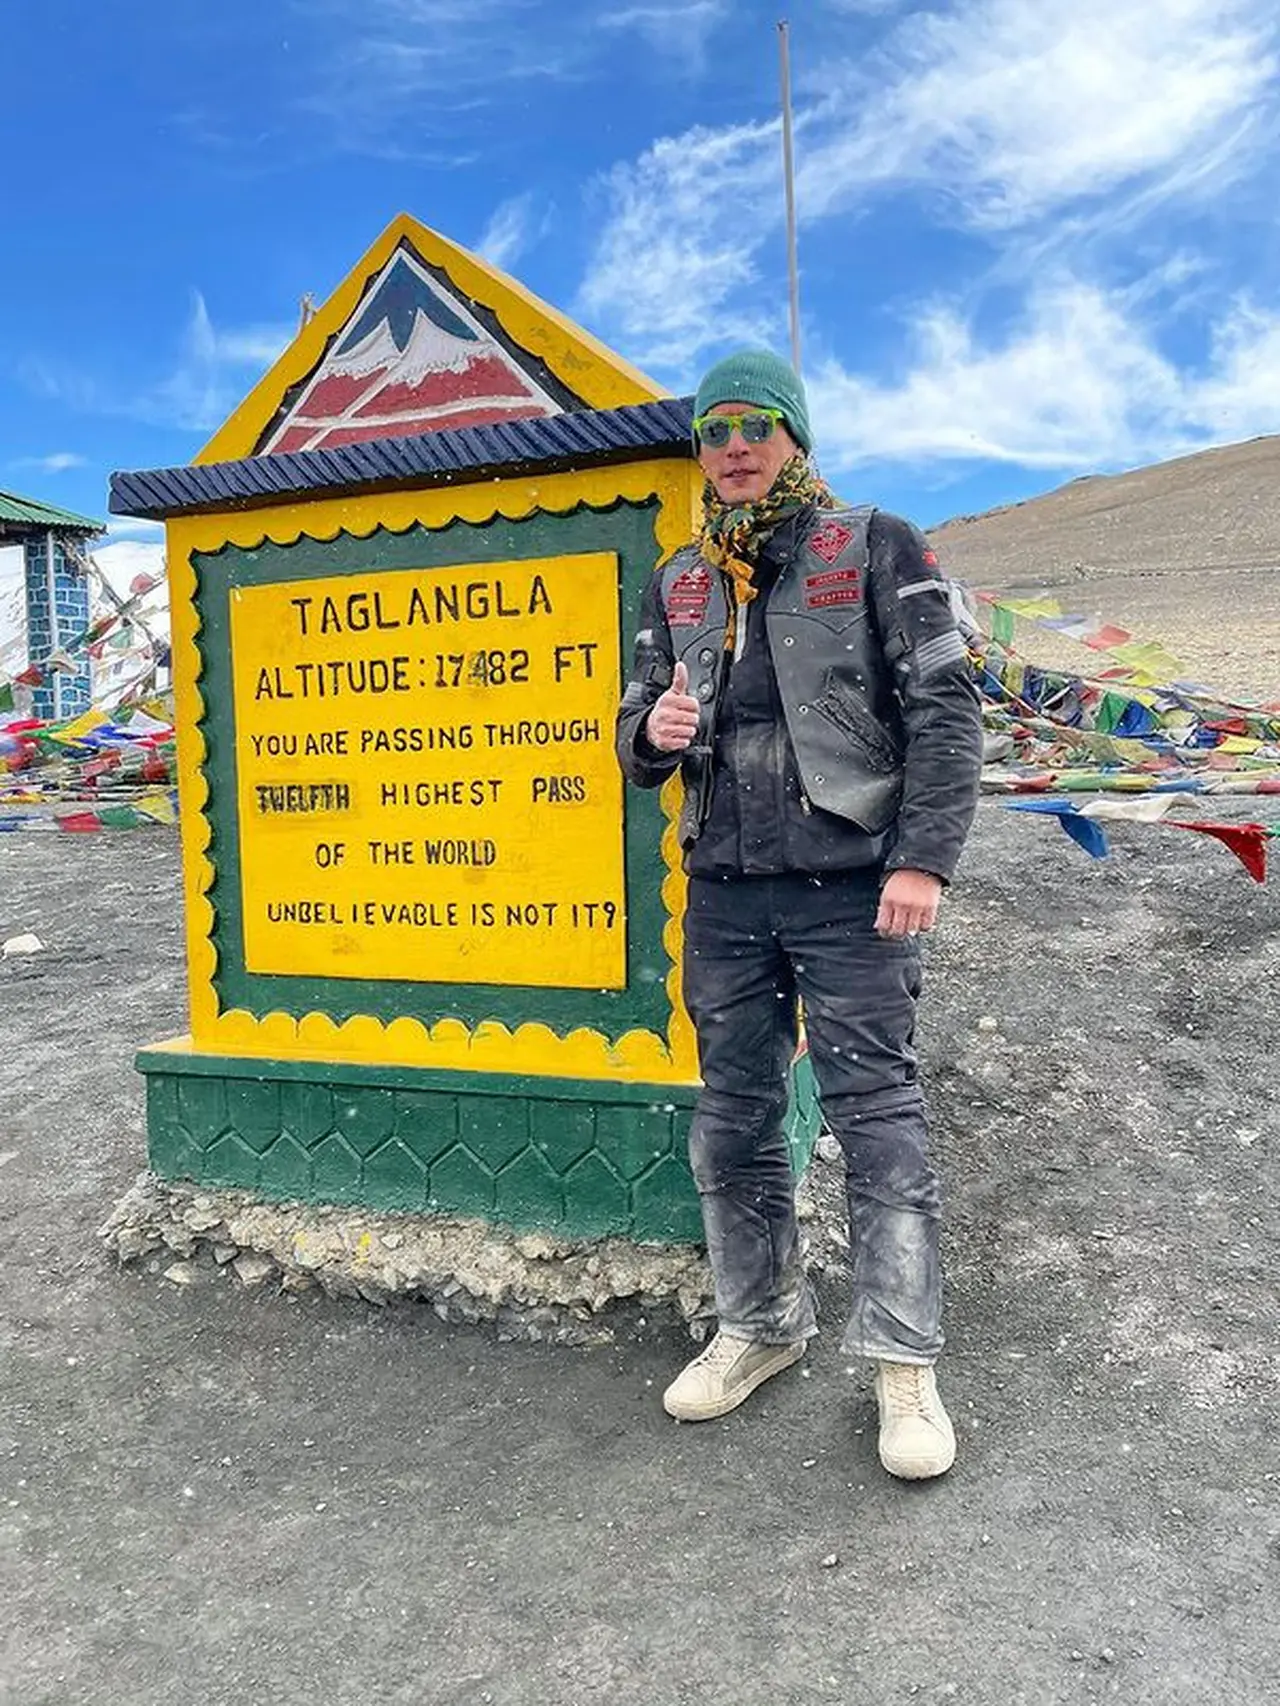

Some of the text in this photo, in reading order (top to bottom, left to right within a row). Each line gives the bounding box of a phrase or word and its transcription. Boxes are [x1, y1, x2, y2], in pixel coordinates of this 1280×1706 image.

[291, 575, 553, 635] TAGLANGLA
[553, 643, 599, 683] FT
[251, 719, 600, 757] YOU ARE PASSING THROUGH
[255, 776, 586, 814] TWELFTH HIGHEST PASS
[316, 839, 496, 869] OF THE WORLD
[267, 901, 458, 928] UNBELIEVABLE
[471, 902, 495, 927] IS
[506, 903, 558, 927] NOT
